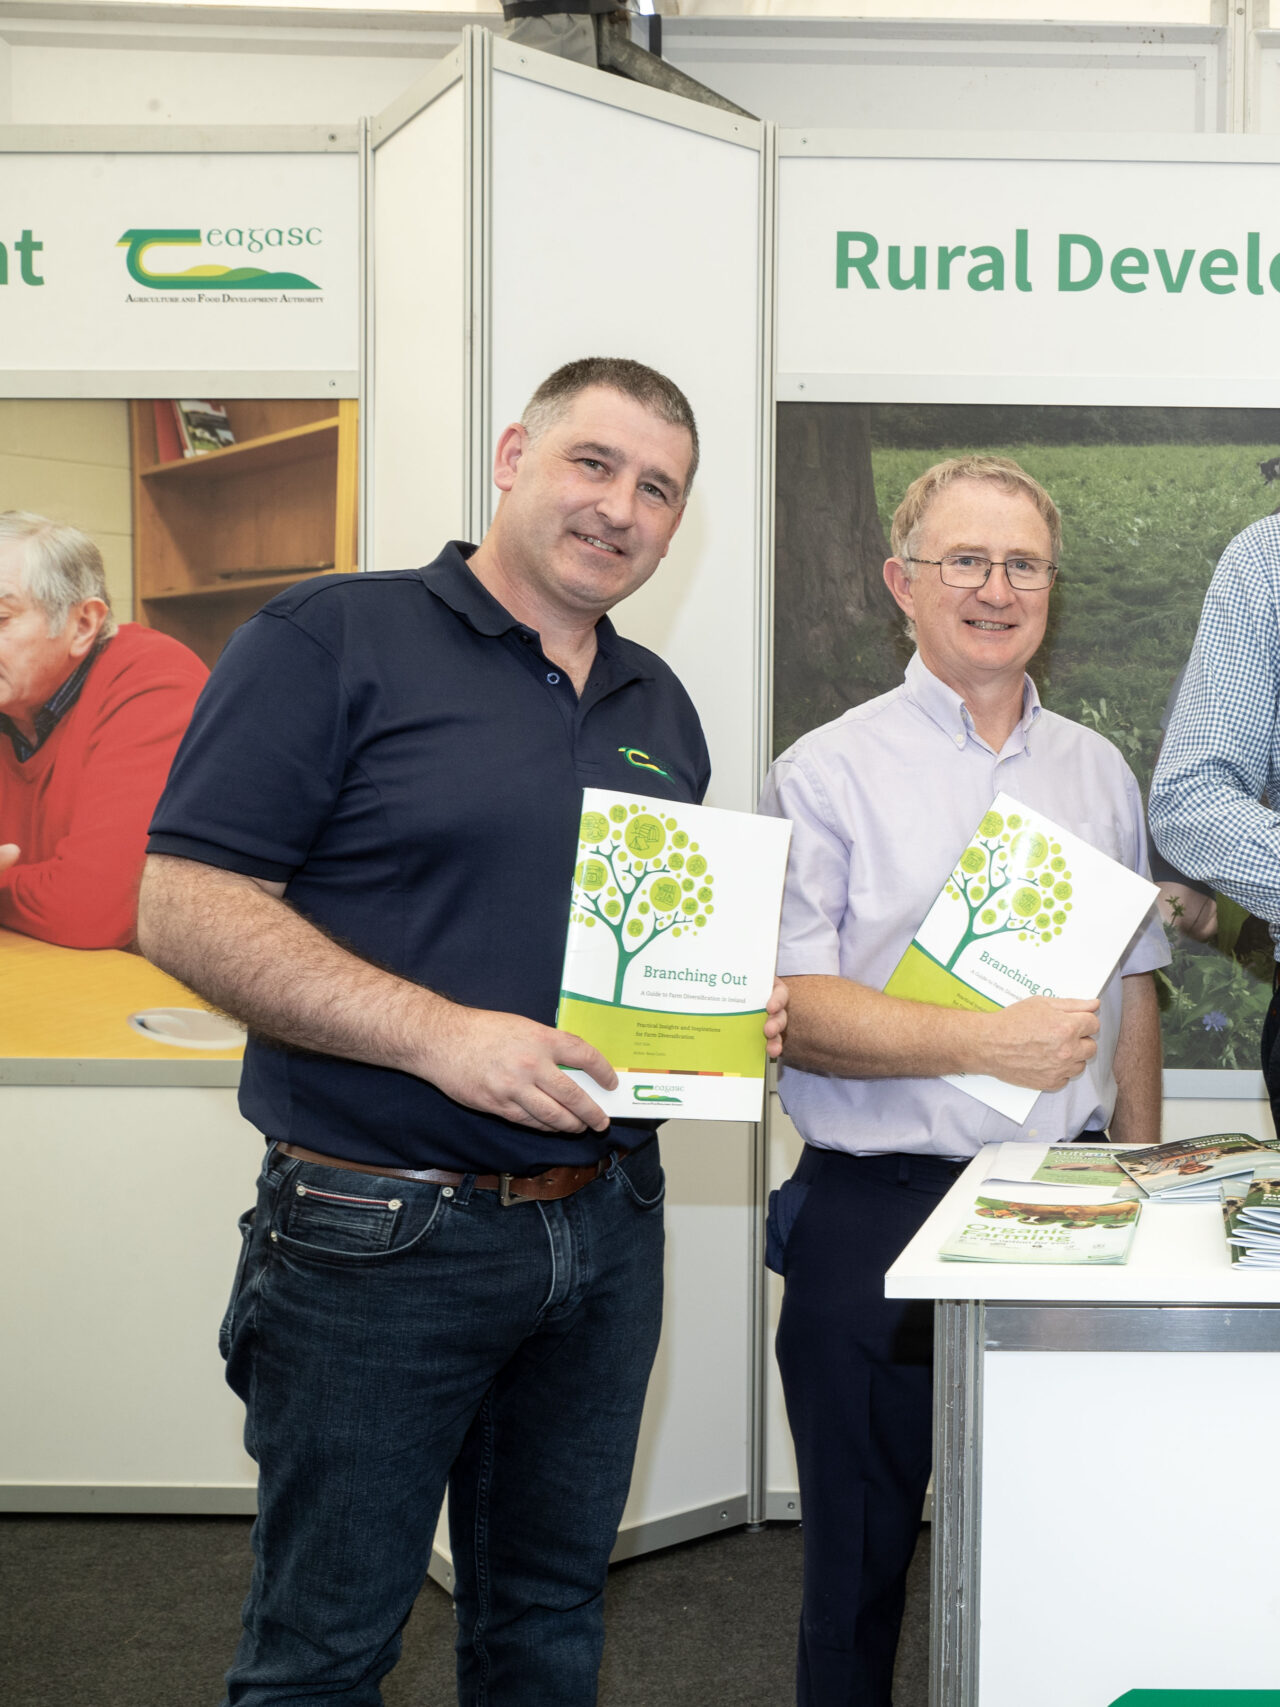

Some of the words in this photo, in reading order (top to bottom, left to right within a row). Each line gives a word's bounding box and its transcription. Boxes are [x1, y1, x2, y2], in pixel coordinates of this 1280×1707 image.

[835, 228, 1033, 293] Rural
[643, 965, 718, 987] Branching
[721, 972, 748, 986] Out
[979, 950, 1041, 996] Branching
[966, 1223, 1072, 1235] Organic
